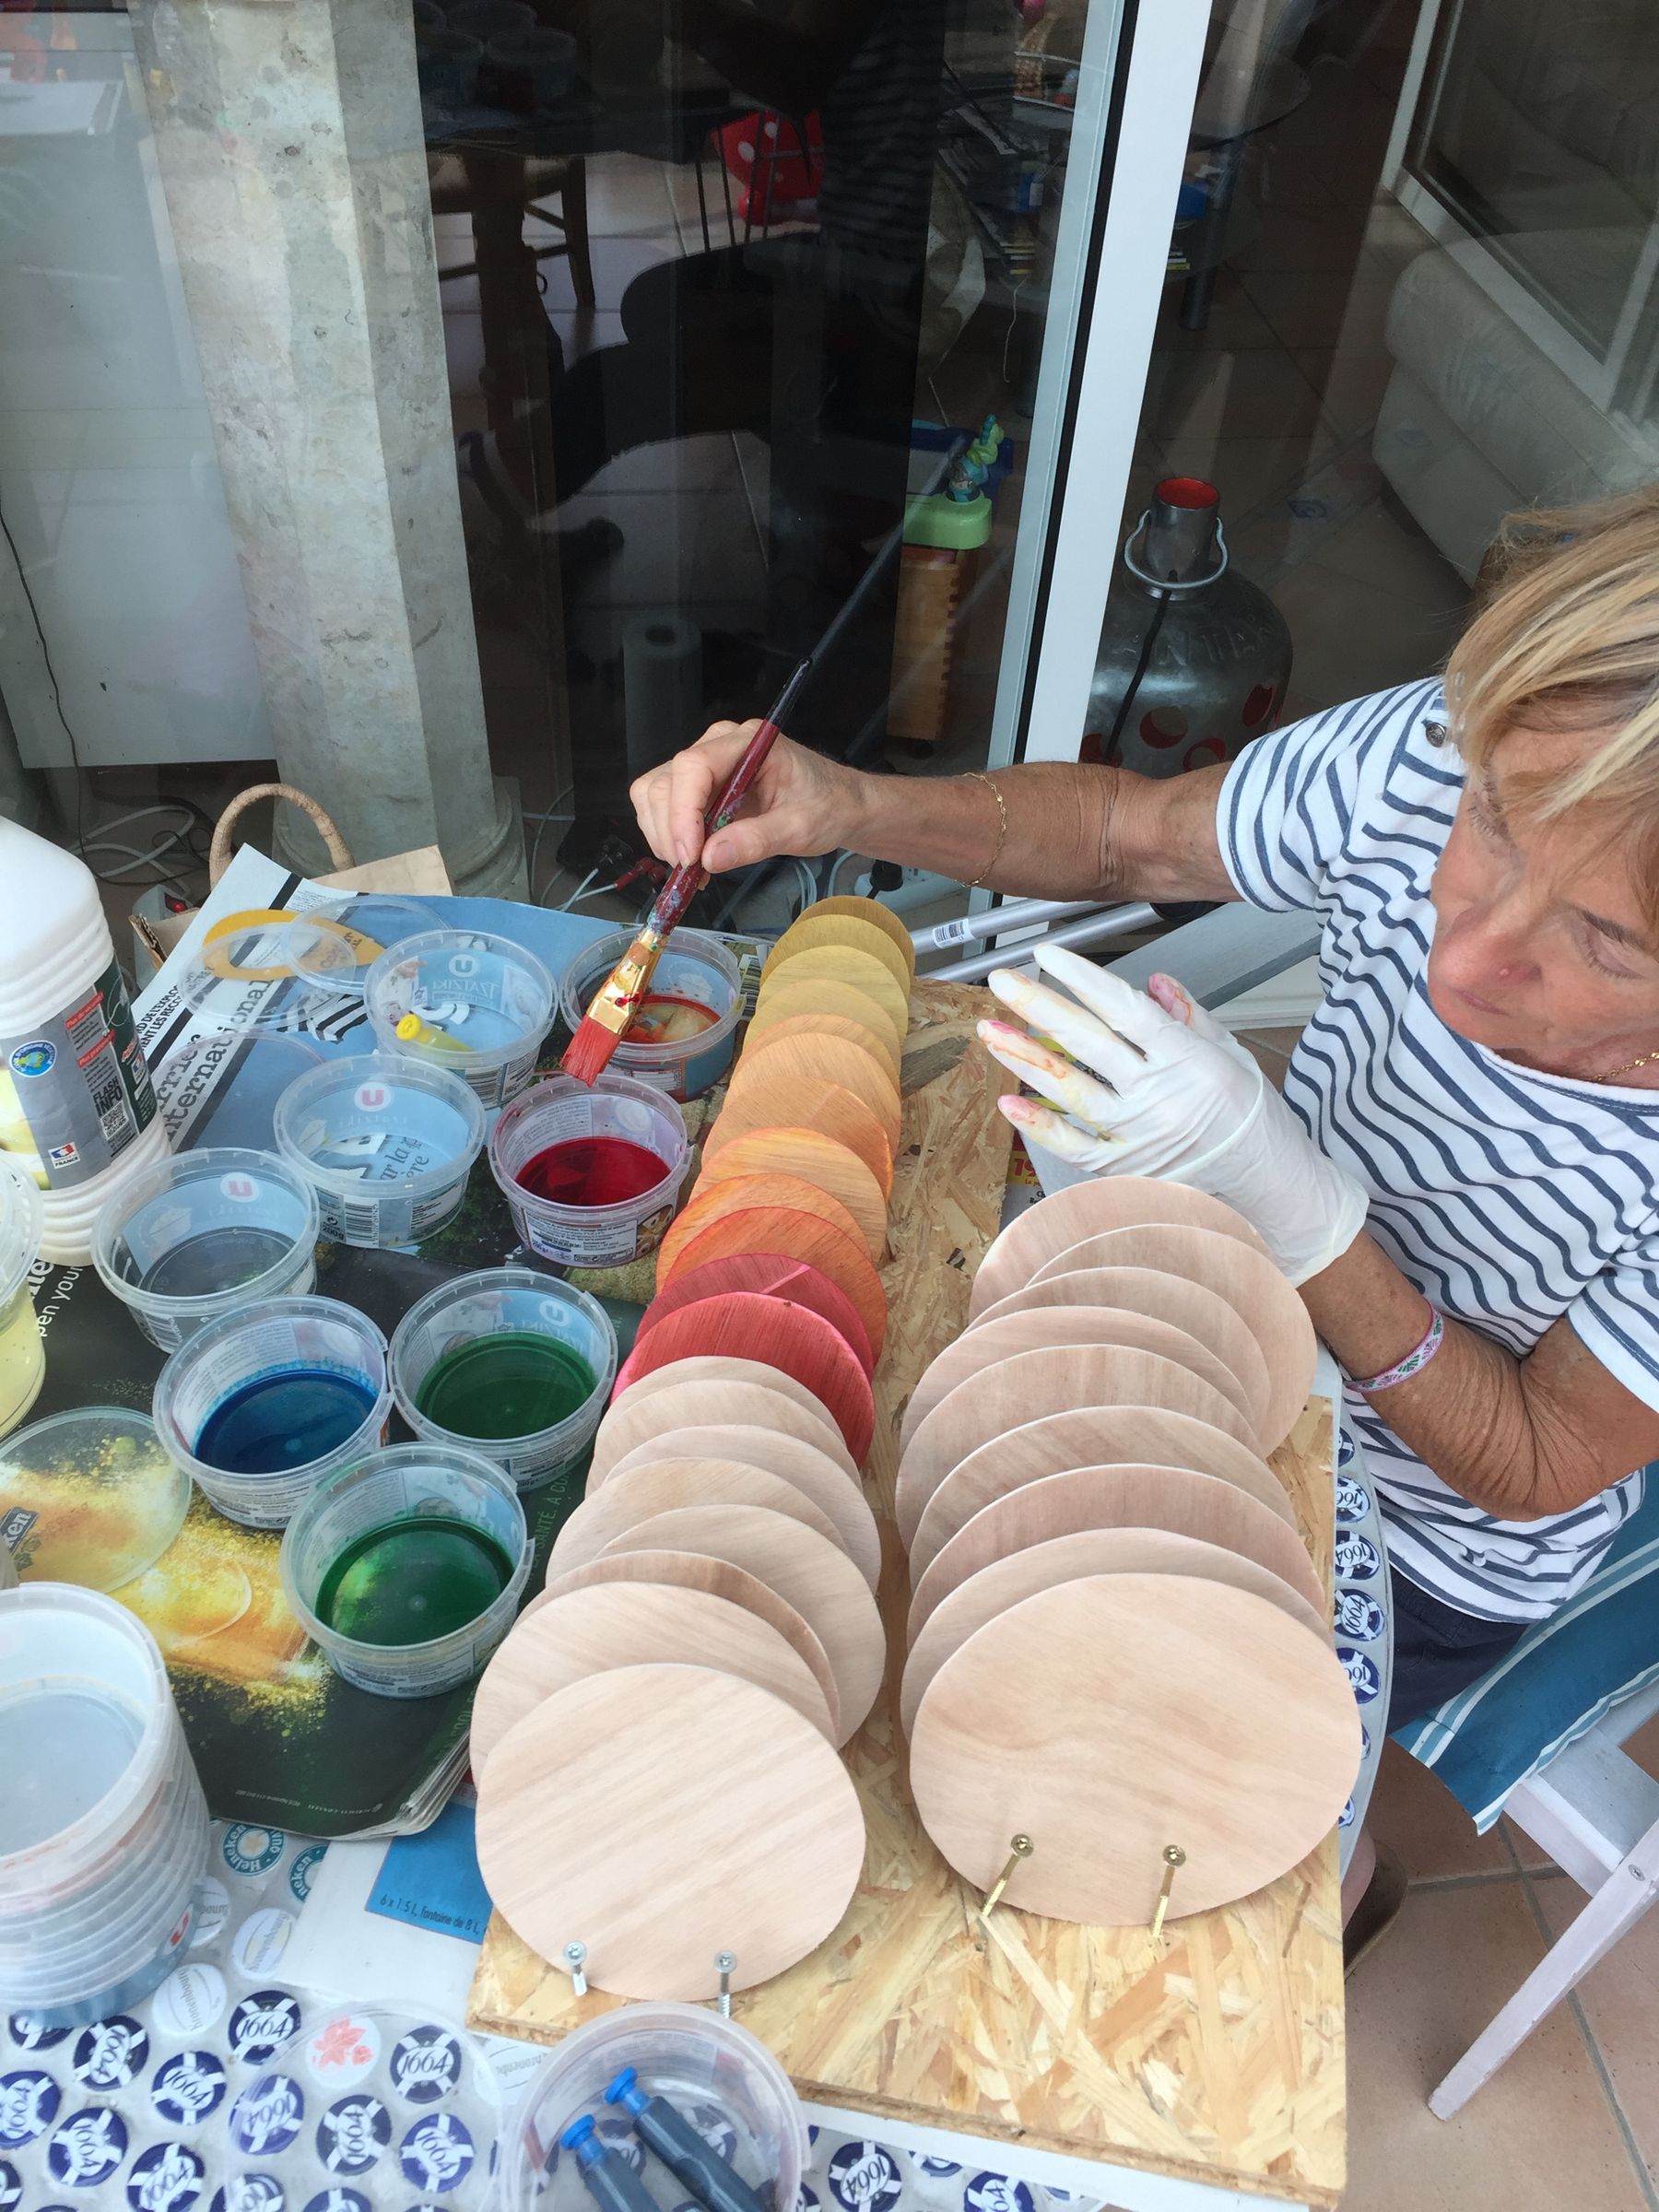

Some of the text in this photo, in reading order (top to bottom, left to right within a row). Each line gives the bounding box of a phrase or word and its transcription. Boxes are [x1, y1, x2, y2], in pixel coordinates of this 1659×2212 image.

[150, 1017, 167, 1030] LES
[162, 980, 275, 1143] nternational
[92, 1077, 120, 1103] FLASH
[95, 1088, 124, 1118] INFO
[1335, 1543, 1368, 1565] 1664
[1345, 1596, 1366, 1633] 1664
[380, 1894, 387, 1906] 6
[240, 2015, 289, 2039] 1664
[91, 2028, 126, 2078] 1664
[400, 2052, 451, 2075] 1664
[163, 2070, 213, 2106] 1664
[7, 2086, 31, 2134] 1664
[248, 2093, 291, 2128] 1664
[73, 2123, 101, 2168] 1664
[344, 2108, 366, 2159] 1664
[417, 2130, 459, 2173] 1664
[845, 2154, 888, 2204] 1664
